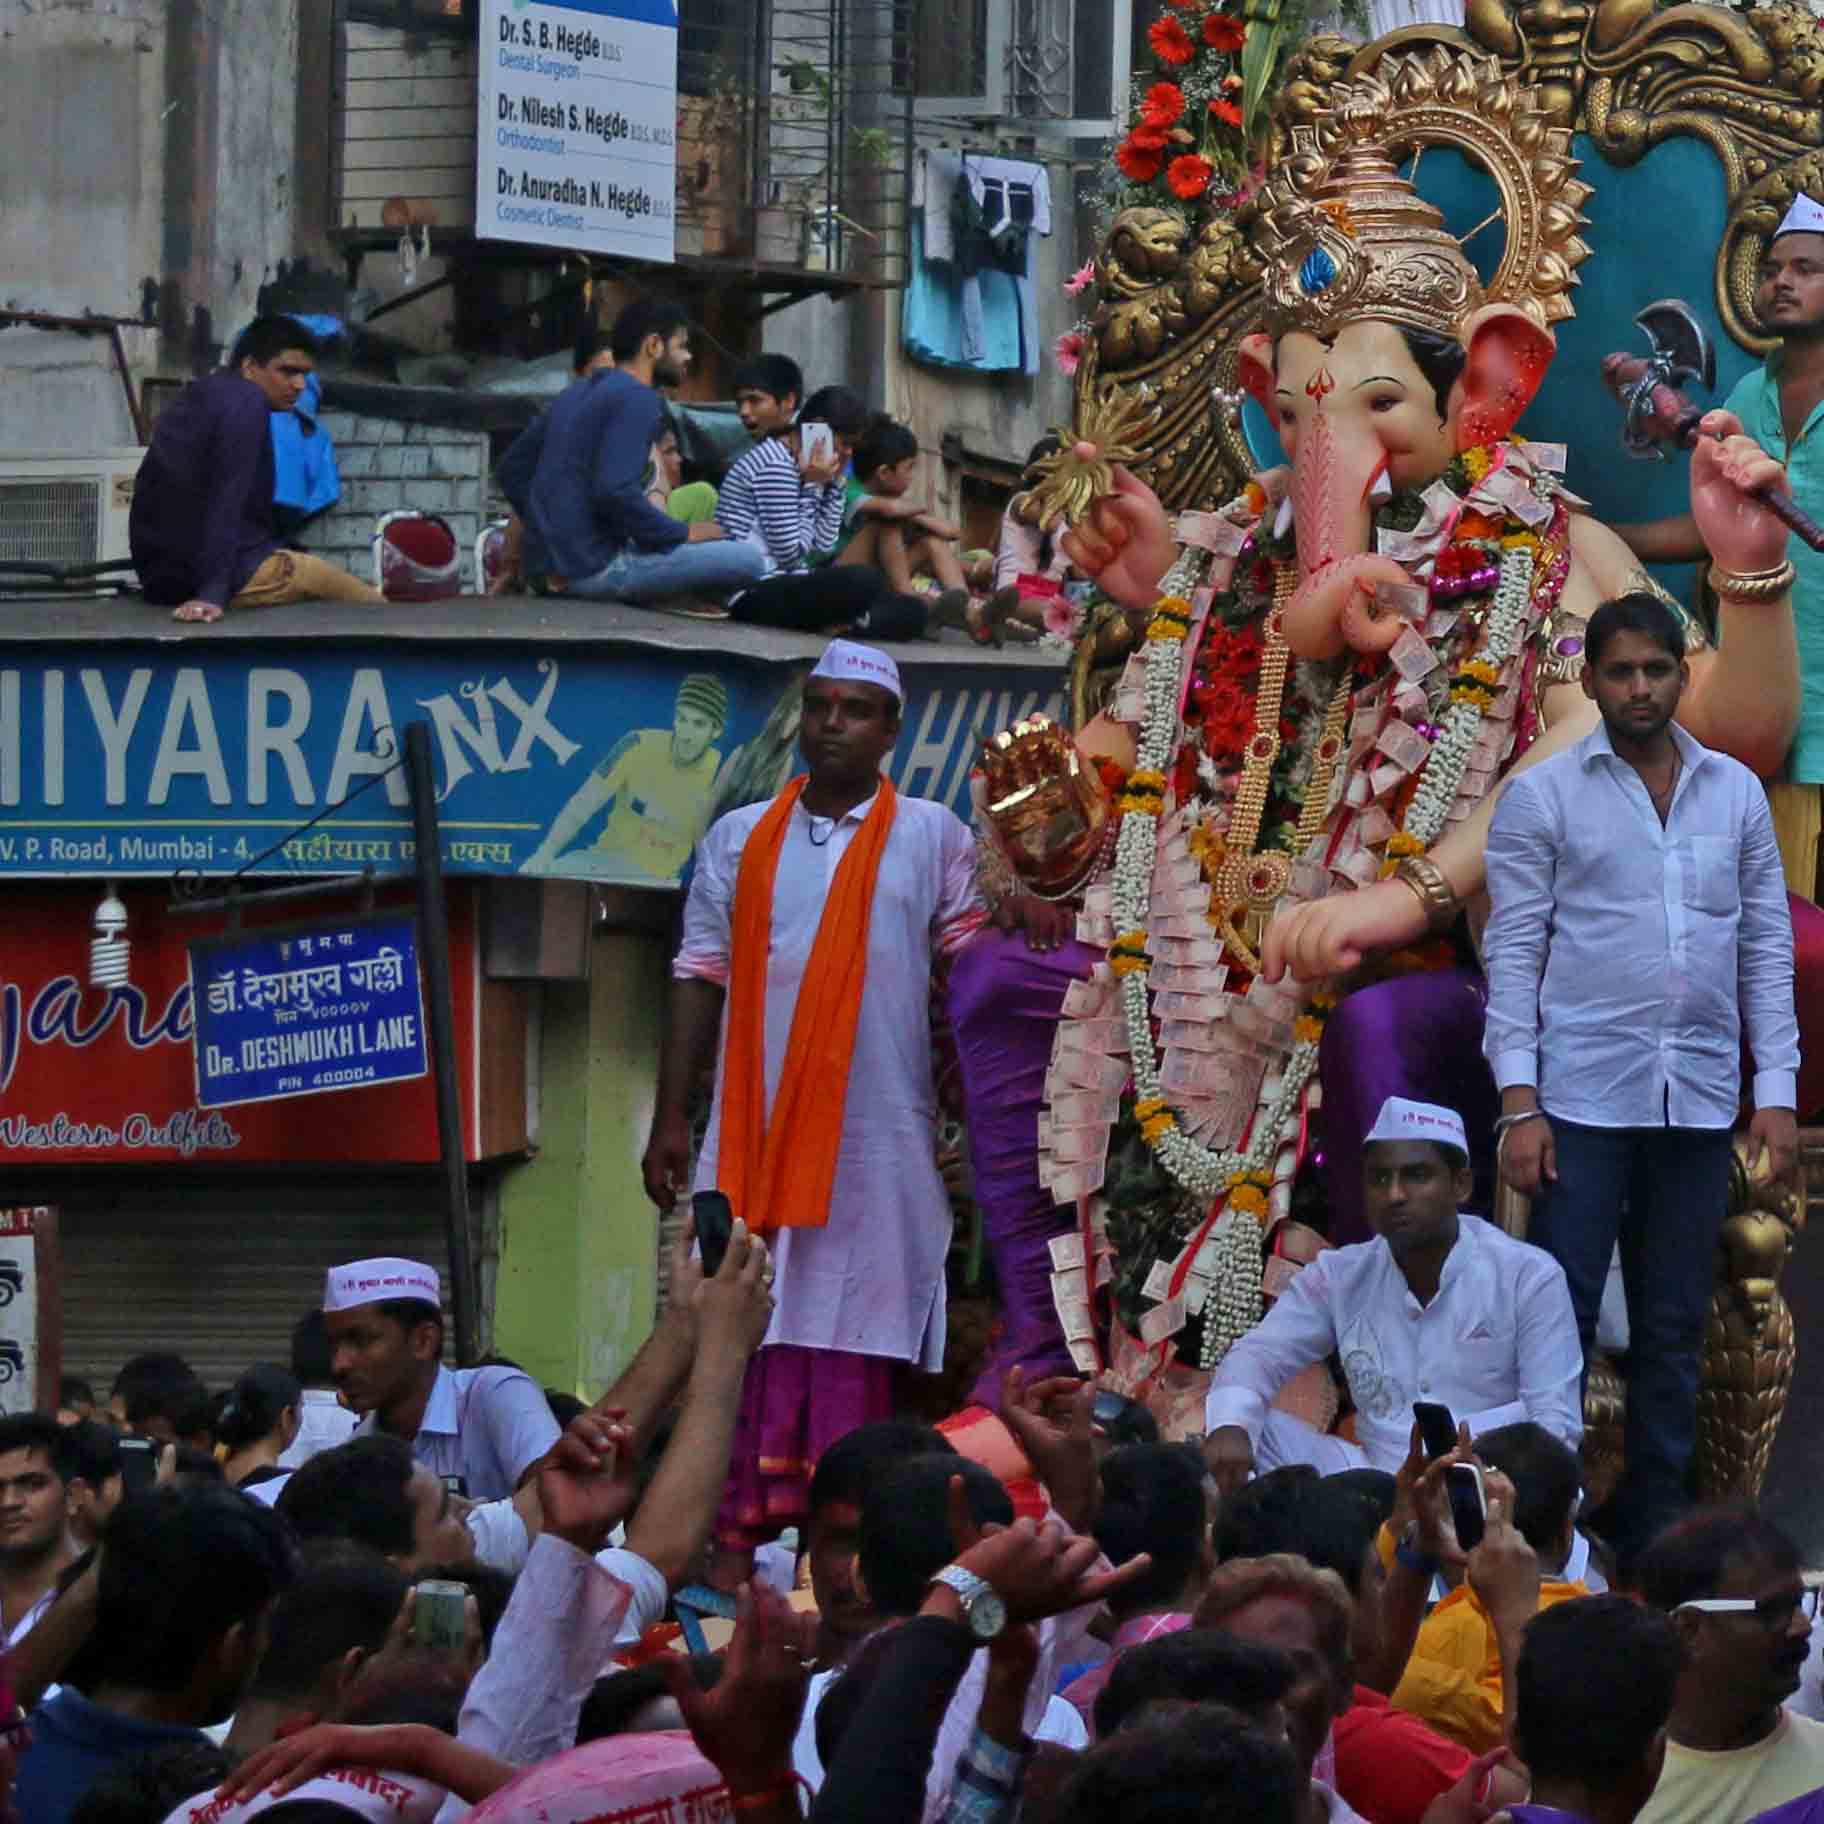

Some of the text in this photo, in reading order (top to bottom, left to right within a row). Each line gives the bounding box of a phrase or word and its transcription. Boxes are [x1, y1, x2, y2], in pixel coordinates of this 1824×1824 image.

[499, 15, 519, 43] Dr.
[522, 18, 537, 46] S.
[539, 21, 553, 50] B.
[556, 23, 600, 61] Hegde
[499, 47, 581, 81] Dental Surgeon
[498, 92, 518, 122] Dr.
[521, 95, 566, 129] Nilesh
[568, 103, 582, 132] S.
[584, 106, 629, 143] Hegde
[497, 166, 516, 196] Dr.
[520, 170, 587, 207] Anuradha
[590, 180, 605, 209] N.
[608, 183, 650, 219] Hegde
[416, 656, 583, 804] NX
[26, 837, 43, 861] P.
[50, 835, 113, 865] Road,
[119, 835, 214, 861] Mumbai
[347, 945, 404, 993] गल्ली
[358, 1014, 417, 1054] LANE
[277, 1065, 376, 1092] PIN 400004
[122, 1111, 241, 1158] Outfits
